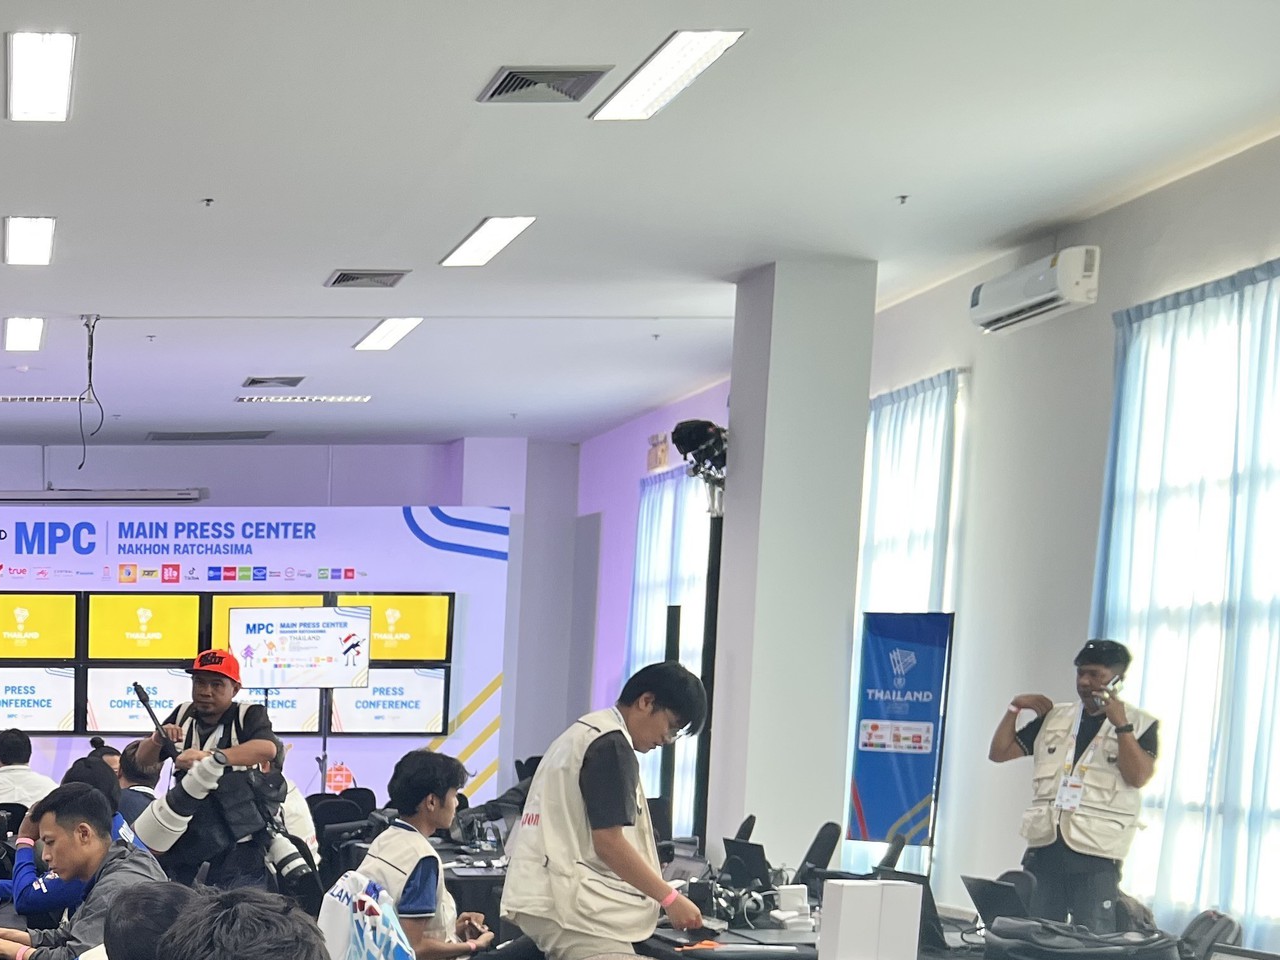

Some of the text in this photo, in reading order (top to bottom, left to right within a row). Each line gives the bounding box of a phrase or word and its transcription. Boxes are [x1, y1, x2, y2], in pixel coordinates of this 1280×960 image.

[118, 522, 316, 539] MAIN PRESS CENTER
[15, 522, 96, 555] MPC
[118, 543, 253, 555] NAKHON RATCHASIMA
[8, 567, 28, 575] true
[246, 623, 274, 634] MPC
[2, 631, 39, 639] THAILAND
[125, 632, 162, 640] THAILAND
[373, 632, 410, 640] THAILAND
[4, 686, 36, 694] PRESS
[126, 687, 158, 695] PSS
[372, 687, 404, 696] PRESS
[867, 688, 933, 702] THAILAND
[110, 700, 174, 708] CONFEENCE
[355, 700, 420, 709] CONFERENCE
